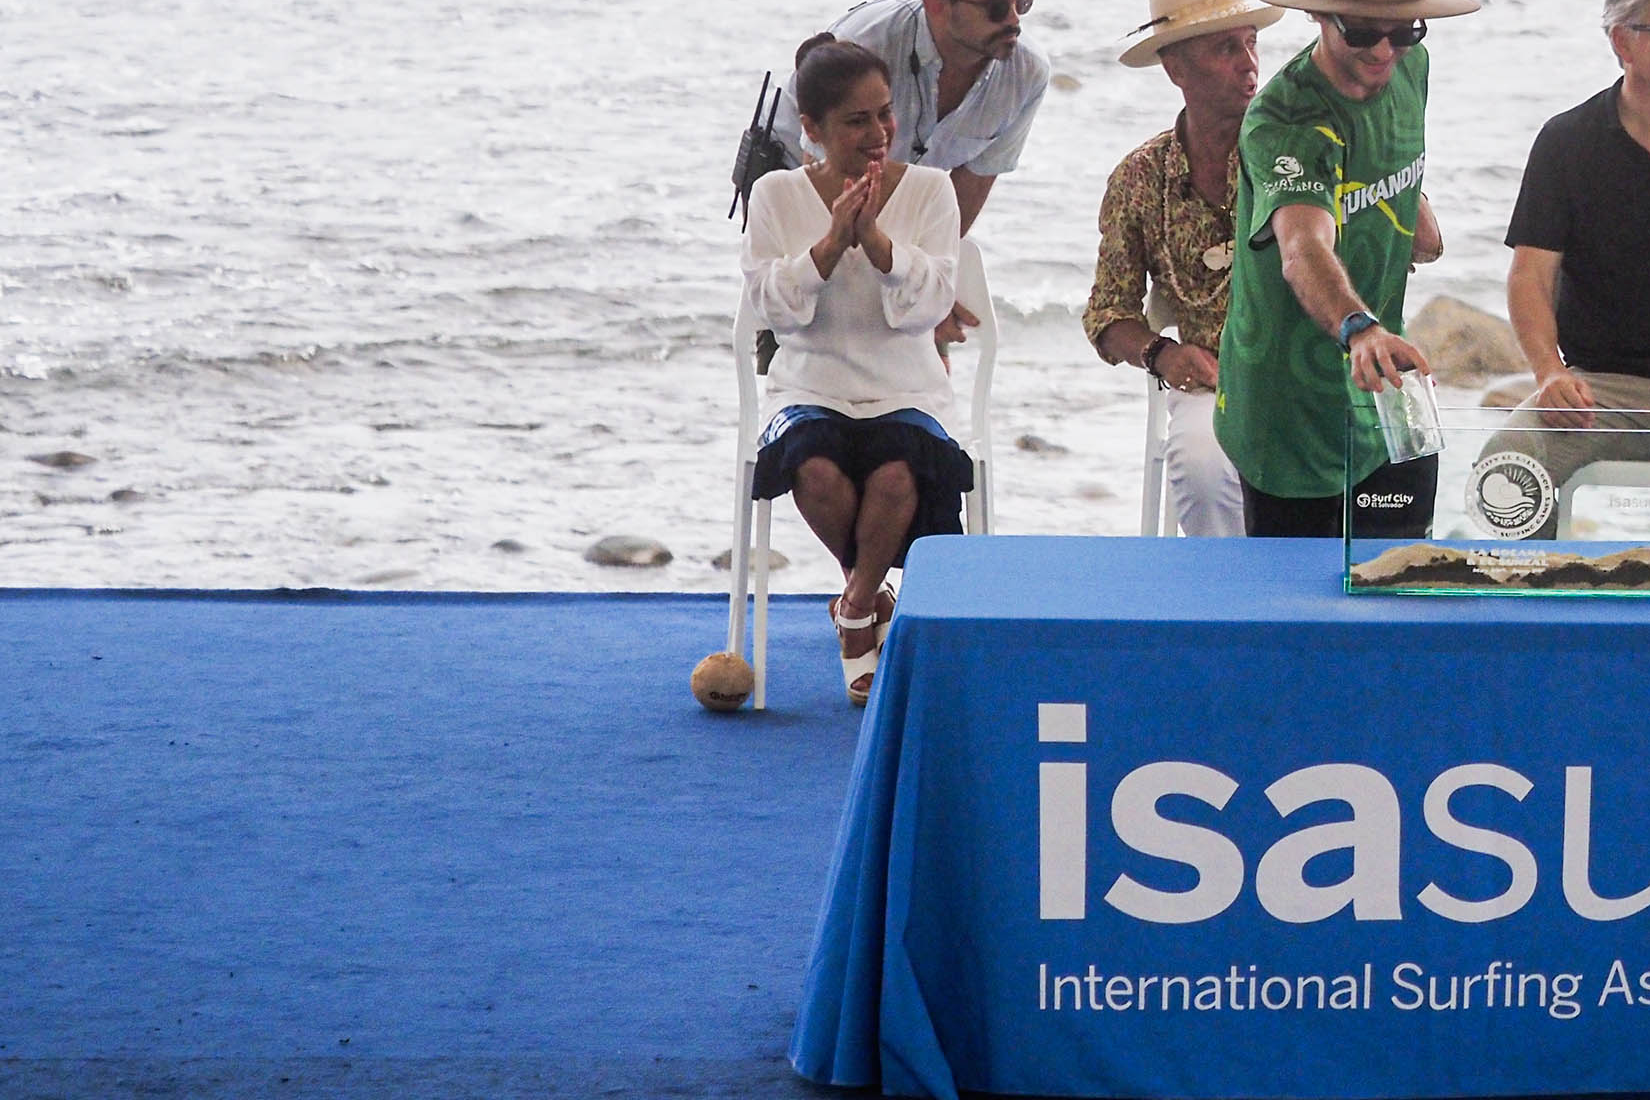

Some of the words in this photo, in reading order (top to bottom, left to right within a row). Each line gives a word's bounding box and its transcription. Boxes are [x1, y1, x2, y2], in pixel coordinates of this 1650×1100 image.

[1371, 493, 1392, 503] Surf
[1393, 493, 1414, 505] City
[1040, 962, 1372, 1011] International
[1391, 961, 1582, 1019] Surfing
